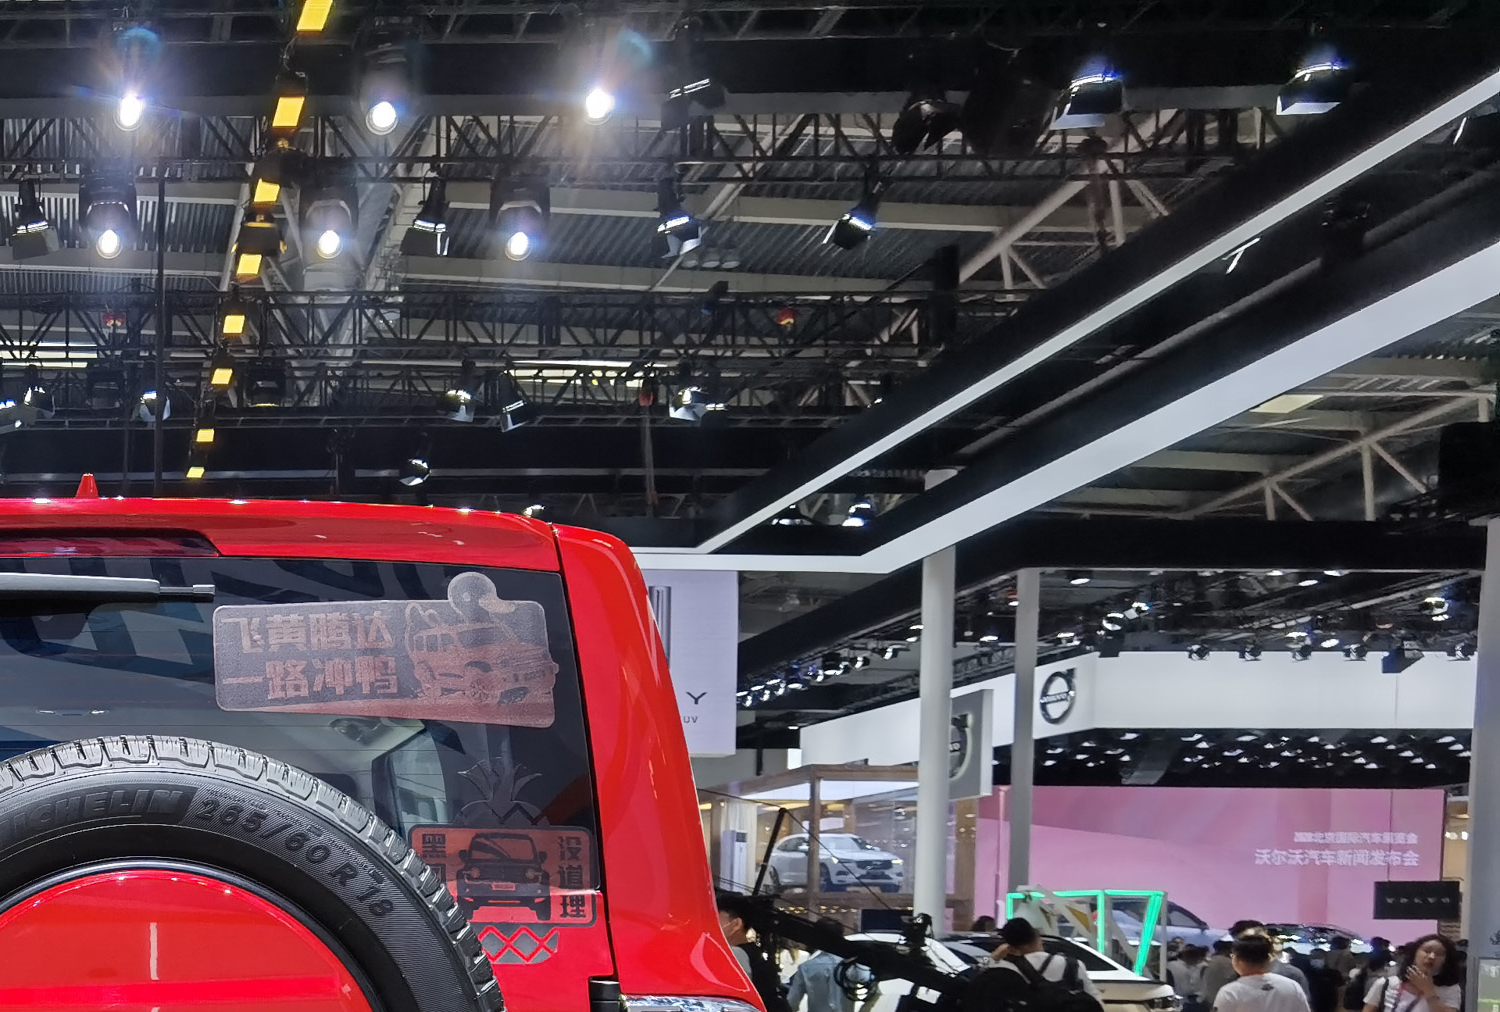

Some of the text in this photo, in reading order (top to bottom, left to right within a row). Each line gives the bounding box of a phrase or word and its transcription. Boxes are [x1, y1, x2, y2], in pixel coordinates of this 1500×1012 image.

[221, 610, 394, 654] 飞黄腾达
[222, 655, 398, 700] 一路冲鸭
[198, 797, 332, 865] 265/60
[327, 861, 359, 887] R
[356, 884, 395, 917] 18
